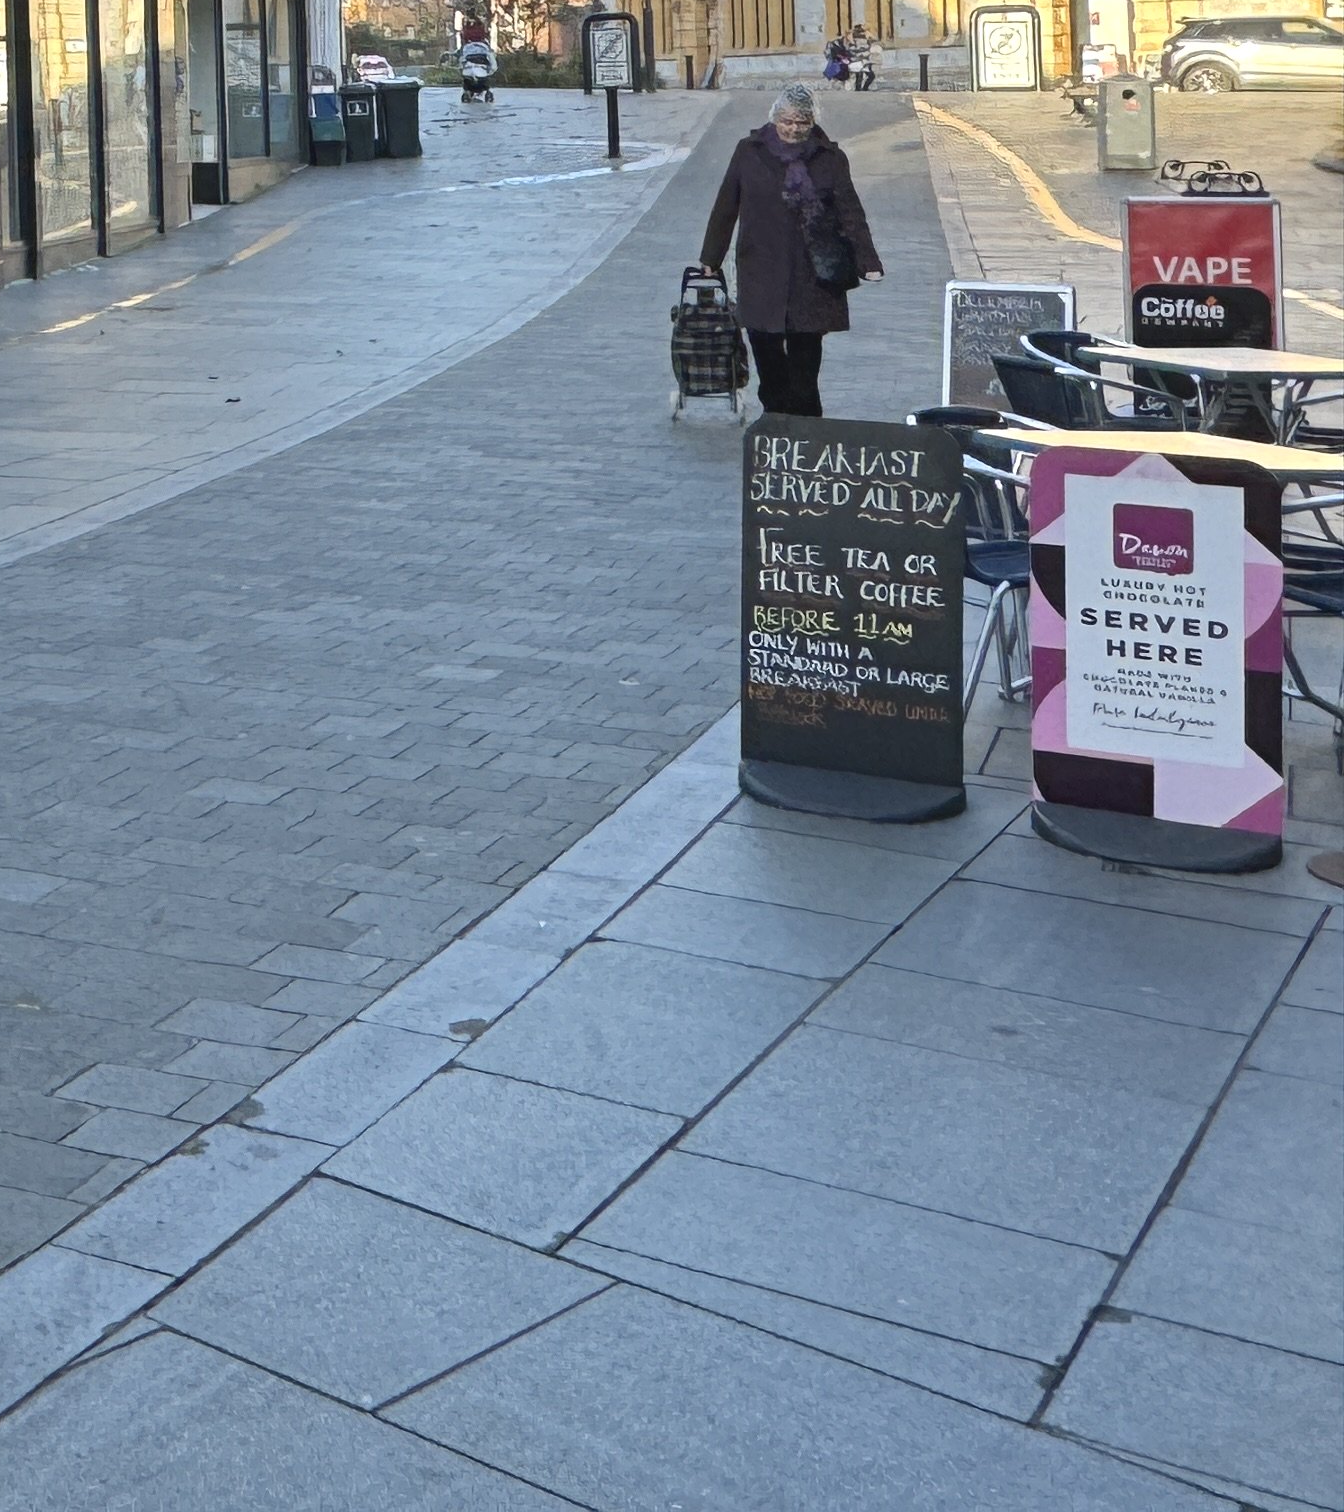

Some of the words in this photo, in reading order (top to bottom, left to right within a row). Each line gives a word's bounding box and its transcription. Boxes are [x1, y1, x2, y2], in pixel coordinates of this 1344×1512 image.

[1152, 256, 1252, 284] VAPE
[1141, 297, 1225, 319] Coffee
[753, 434, 925, 477] BREAKFAST
[750, 472, 850, 506] SERVED
[860, 486, 904, 512] ALL
[910, 489, 961, 524] DAY
[757, 527, 825, 567] FREE
[841, 547, 890, 571] TEA
[904, 554, 937, 576] OR
[759, 568, 844, 599] FILTER
[860, 580, 945, 608] COFFEE
[1103, 590, 1205, 608] CHOCOLATE
[1174, 585, 1206, 596] HOT
[753, 605, 840, 632] BEFORE
[1080, 608, 1229, 639] SERVED
[748, 631, 798, 655] ONLY
[806, 638, 850, 659] WITH
[857, 647, 873, 660] A
[1106, 639, 1203, 666] HERE
[856, 666, 880, 682] OR
[887, 668, 950, 693] LARGE
